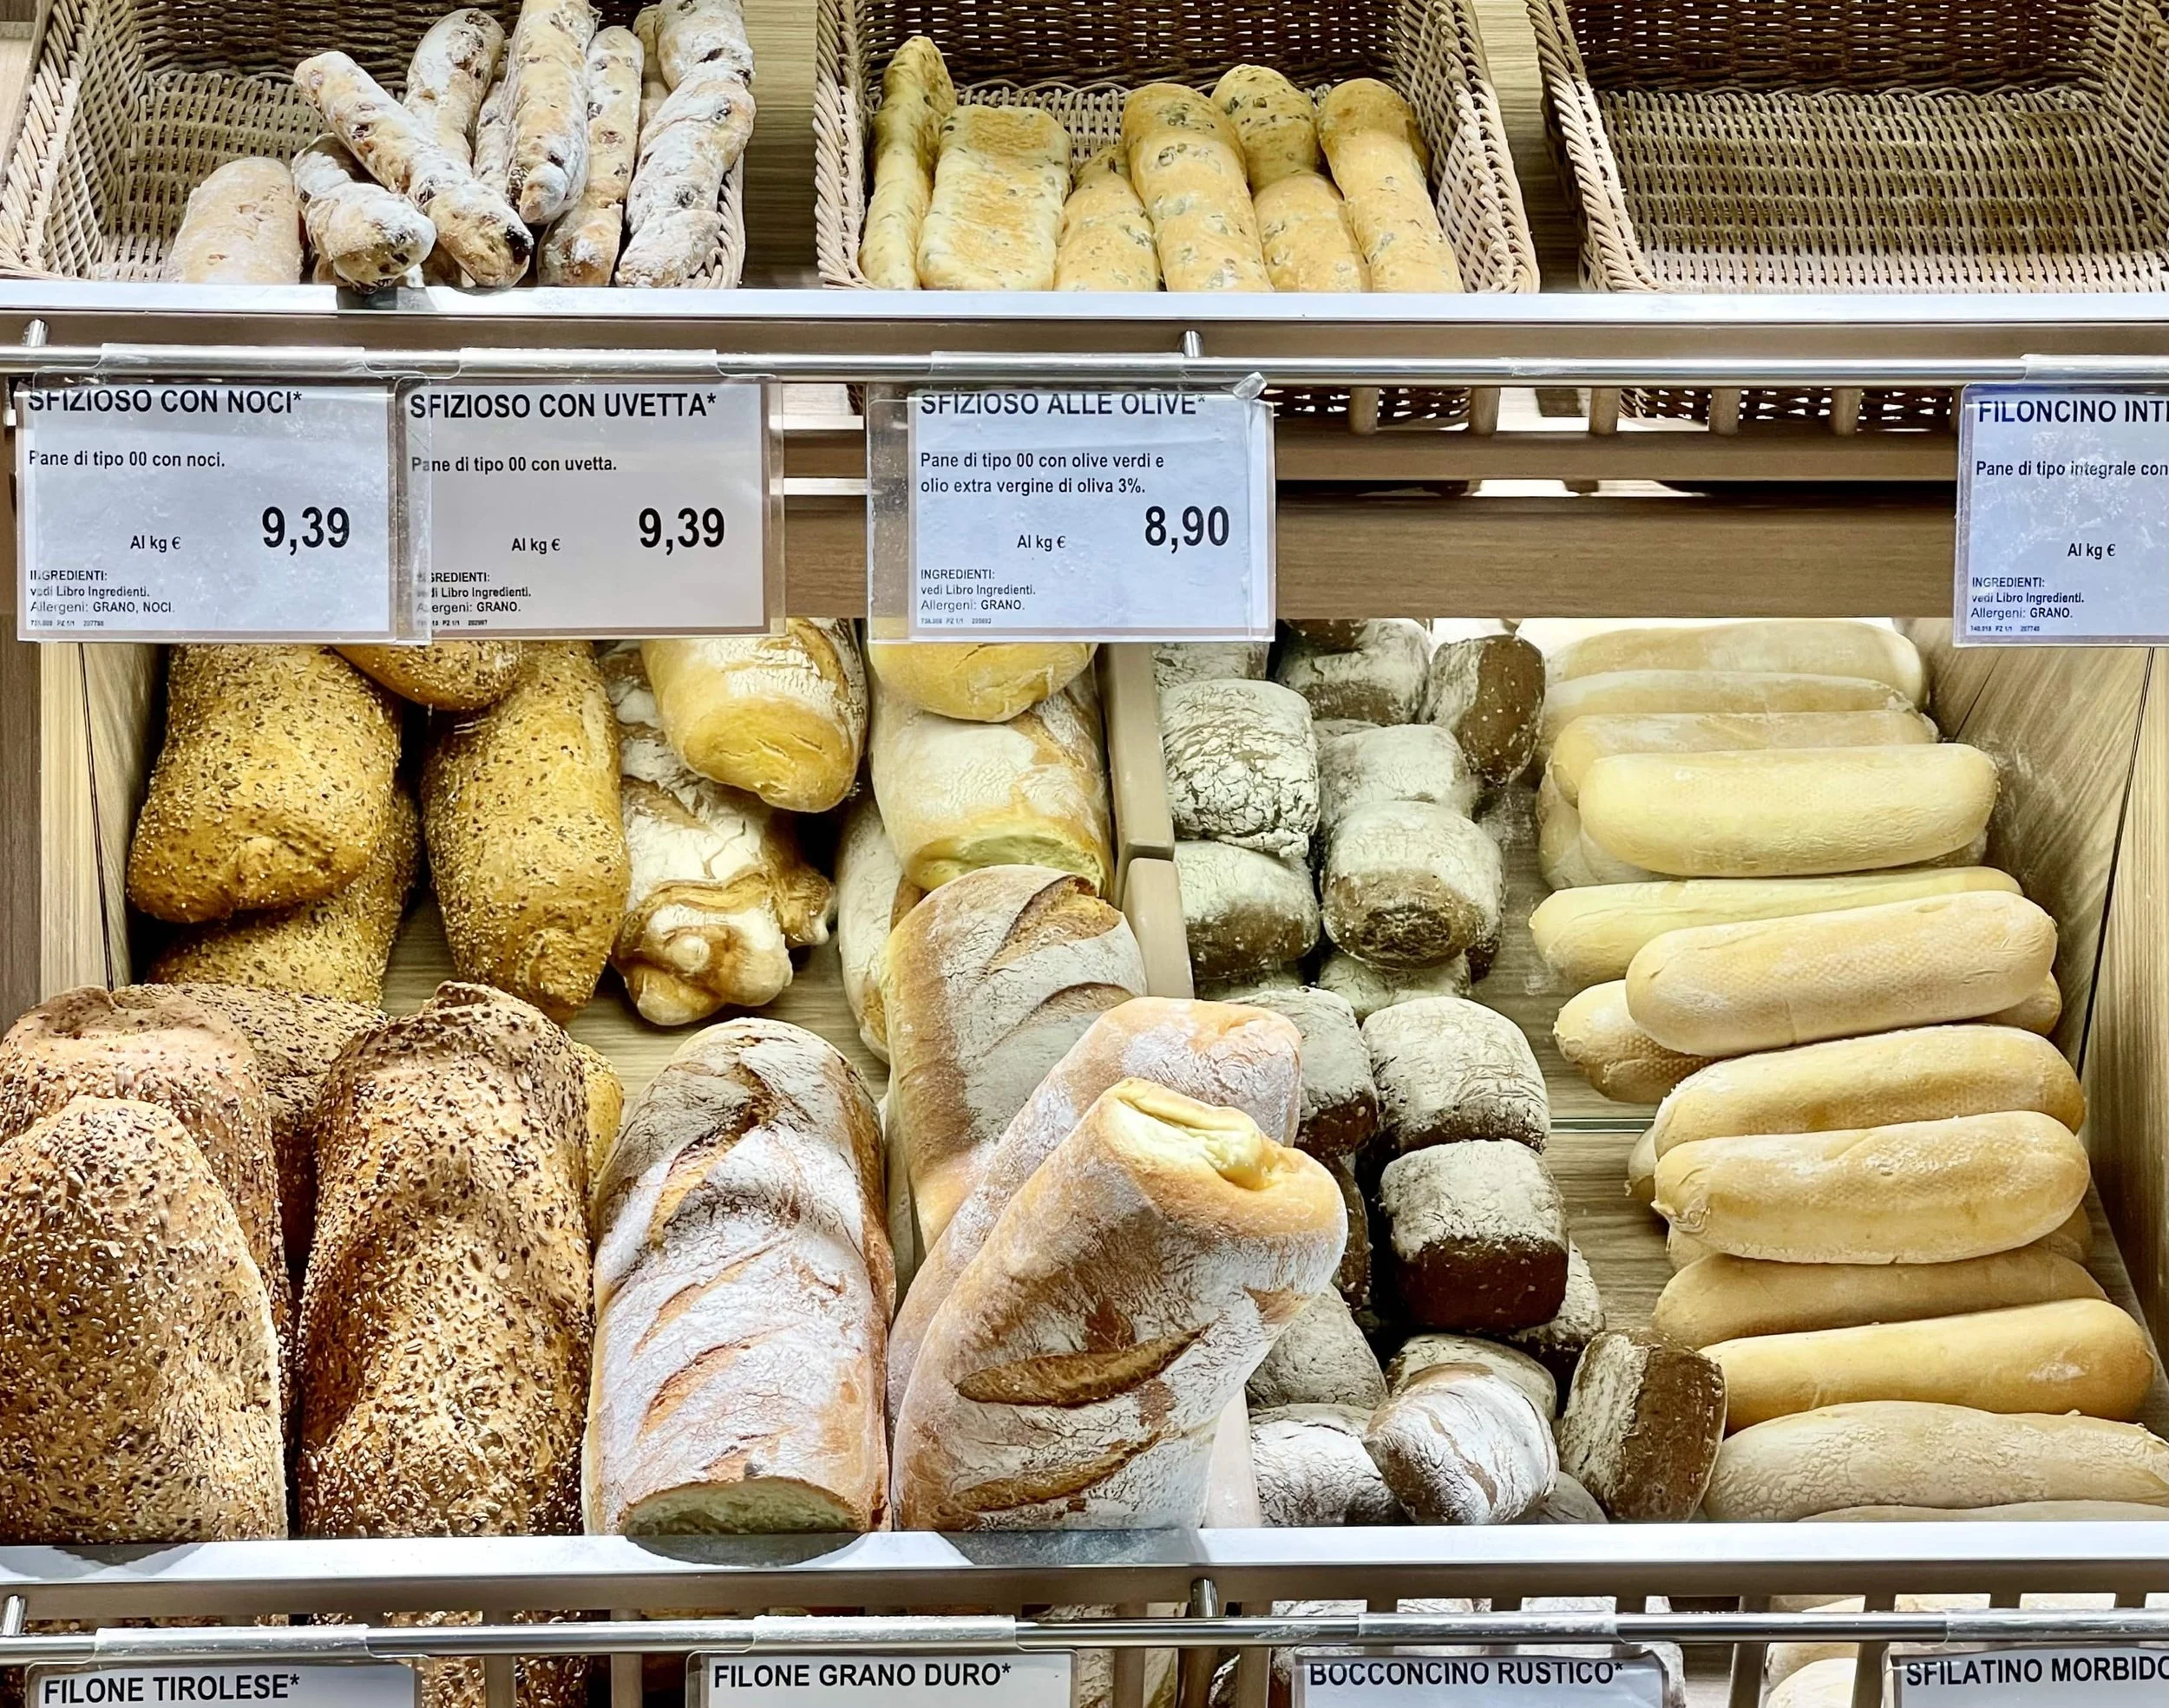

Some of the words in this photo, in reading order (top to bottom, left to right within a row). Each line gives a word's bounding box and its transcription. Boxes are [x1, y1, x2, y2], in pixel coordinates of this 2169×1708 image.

[29, 389, 152, 412] SFIZIOSO
[161, 389, 218, 413] CON
[410, 394, 530, 418] SFIZIOSO
[539, 394, 595, 418] CON
[921, 393, 1039, 415] SFIZIOSO
[1047, 393, 1113, 415] ALLE
[1978, 400, 2116, 422] FILONCINO
[2125, 401, 2169, 422] INT
[29, 450, 68, 466] Pane
[74, 450, 88, 466] di
[94, 450, 123, 469] tipo
[129, 451, 147, 466] 00
[153, 455, 180, 467] con
[187, 451, 226, 467] noci.
[411, 456, 450, 471] Pane
[455, 456, 469, 471] di
[474, 456, 504, 474] tipo
[508, 456, 527, 471] 00
[531, 460, 560, 471] con
[566, 457, 617, 471] uvetta.
[921, 453, 958, 468] Pane
[964, 453, 978, 468] di
[982, 453, 1011, 472] tipo
[1016, 453, 1033, 468] 00
[1039, 456, 1066, 468] con
[1071, 453, 1108, 468] olive
[1112, 453, 1150, 468] verdi
[1155, 456, 1164, 468] e
[1976, 461, 2013, 476] Pane
[2018, 461, 2032, 475] di
[2037, 461, 2066, 479] tipo
[2070, 461, 2136, 479] integrale
[2140, 464, 2168, 475] con
[921, 478, 948, 493] olio
[953, 479, 992, 493] extra
[997, 478, 1053, 496] vergine
[1058, 478, 1072, 493] di
[1077, 478, 1113, 493] oliva
[1118, 478, 1145, 494] 3%.
[262, 506, 351, 555] 9,39
[639, 507, 724, 555] 9,39
[1145, 506, 1229, 553] 8,90
[130, 536, 145, 550] Al
[149, 536, 167, 553] kg
[172, 537, 181, 550] €
[512, 538, 526, 551] Al
[530, 538, 547, 554] kg
[551, 538, 560, 551] €
[1017, 535, 1031, 548] Al
[1036, 534, 1052, 552] kg
[1057, 535, 1066, 548] €
[2067, 544, 2082, 557] Al
[2086, 543, 2103, 560] kg
[2107, 544, 2116, 557] €
[921, 569, 995, 579] INGREDIENTI:
[1972, 577, 2046, 587] INGREDIENTI:
[56, 586, 85, 597] Libro
[88, 586, 150, 599] Ingredienti.
[441, 587, 469, 597] Libro
[472, 586, 532, 599] Ingredienti.
[921, 585, 943, 595] vedi
[947, 585, 973, 595] Libro
[976, 585, 1036, 597] Ingredienti.
[1972, 592, 1994, 603] vedi
[1995, 592, 2023, 603] Libro
[2026, 592, 2085, 605] Ingredienti.
[30, 602, 88, 615] Allergeni:
[93, 601, 139, 613] GRANO,
[143, 601, 175, 612] NOCI.
[416, 602, 472, 615] Aergeni:
[476, 601, 521, 612] GRANO.
[921, 599, 977, 612] Allergeni:
[980, 599, 1026, 610] GRANO.
[1970, 607, 2026, 620] Allergeni:
[2029, 607, 2073, 618] GRANO.
[714, 1664, 809, 1688] FILONE
[819, 1664, 916, 1686] GRANO
[1309, 1662, 1490, 1685] BOCCONCINO
[1906, 1659, 2042, 1686] SFILATINO
[44, 1677, 143, 1704] FILONE
